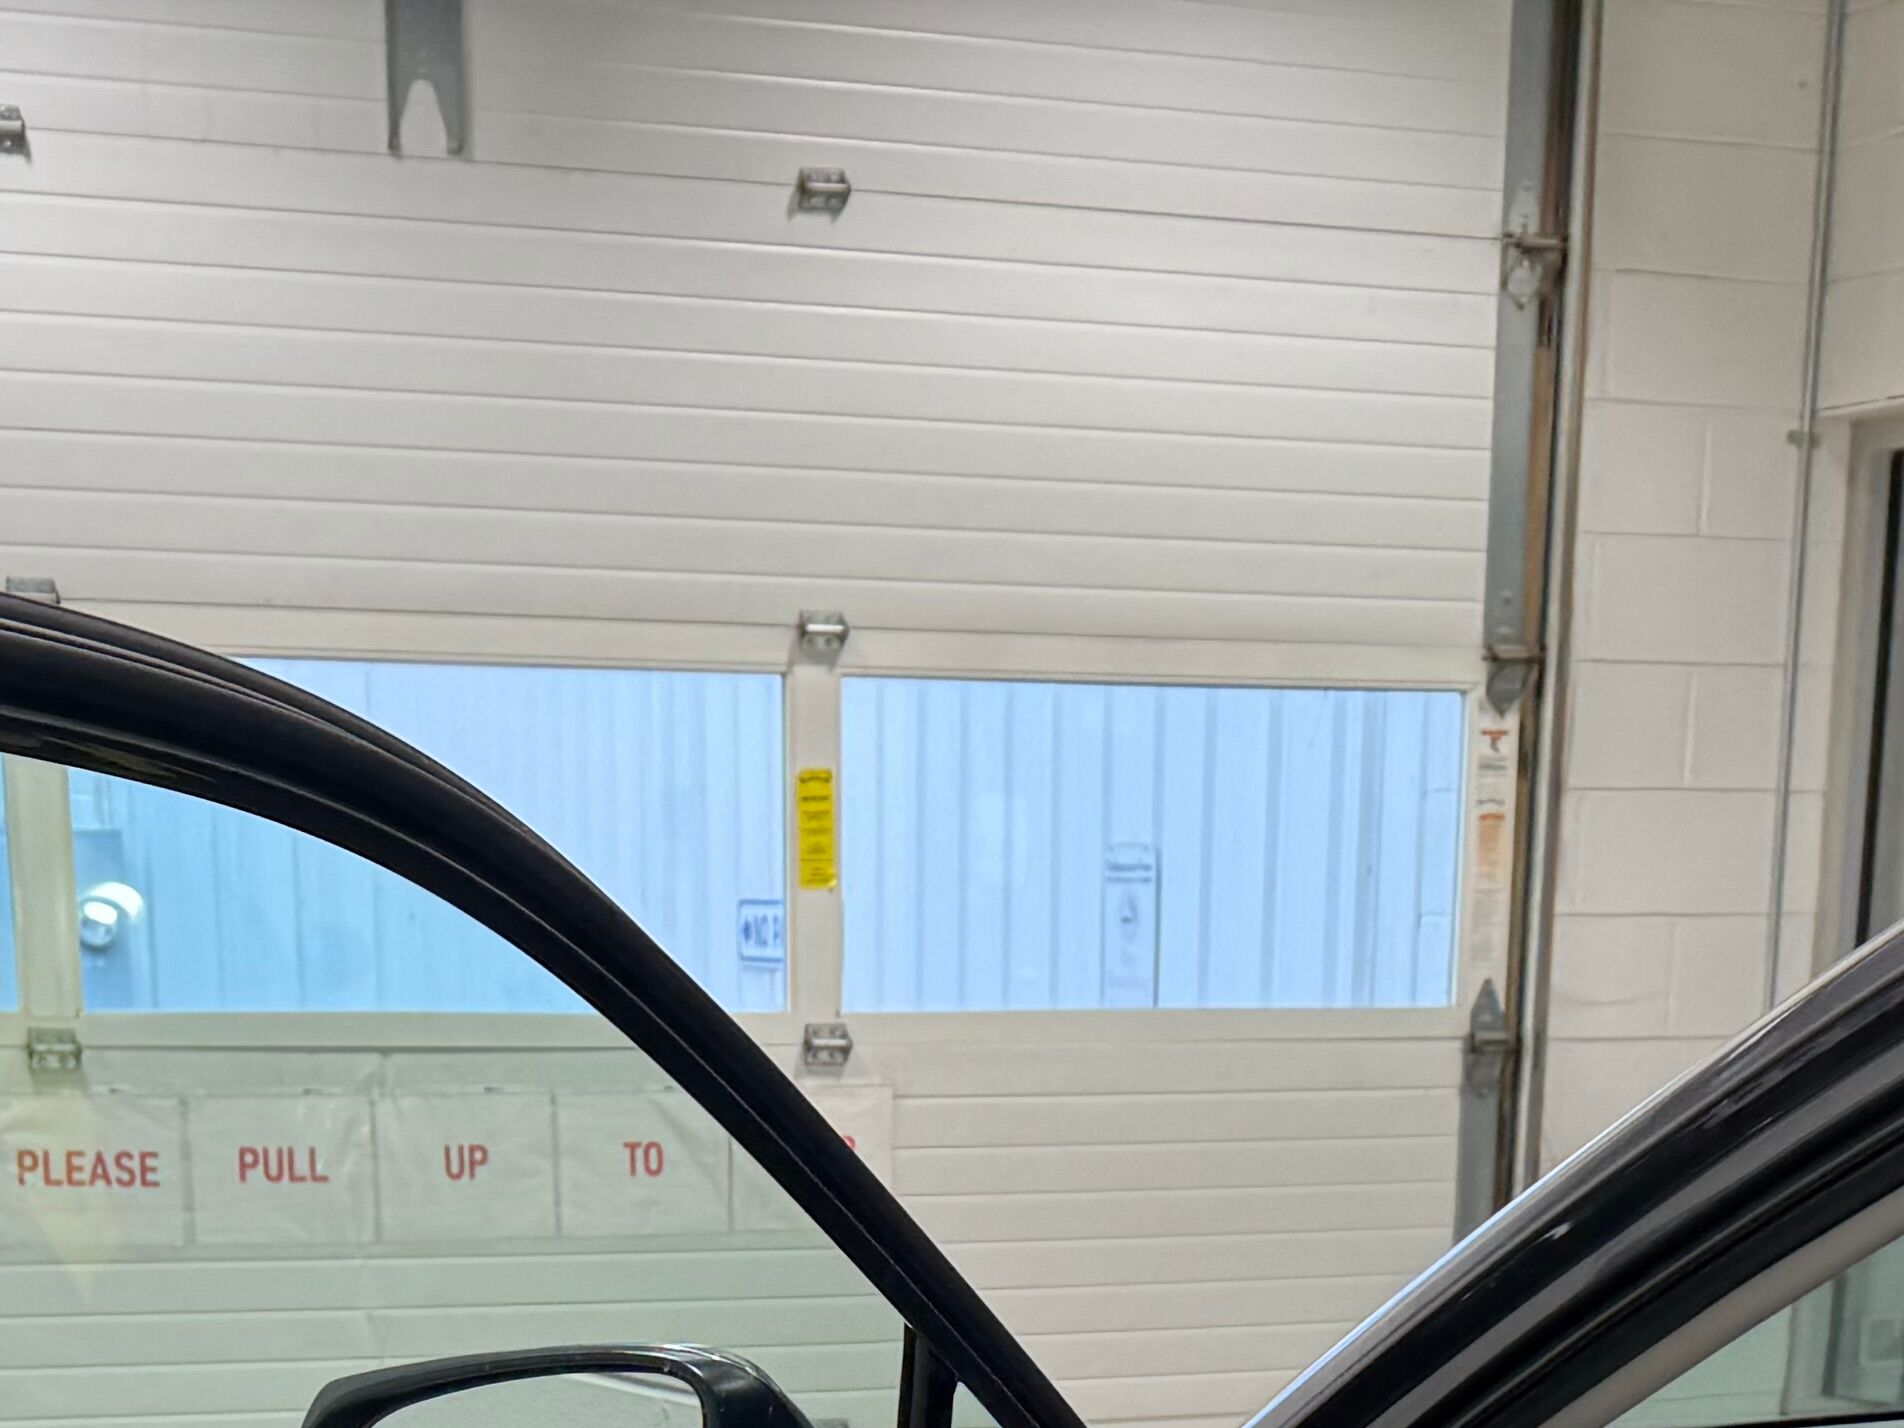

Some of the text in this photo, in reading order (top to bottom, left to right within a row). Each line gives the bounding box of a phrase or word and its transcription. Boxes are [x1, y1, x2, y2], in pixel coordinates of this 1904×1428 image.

[15, 1141, 664, 1189] PLEASE PULL UP TO
